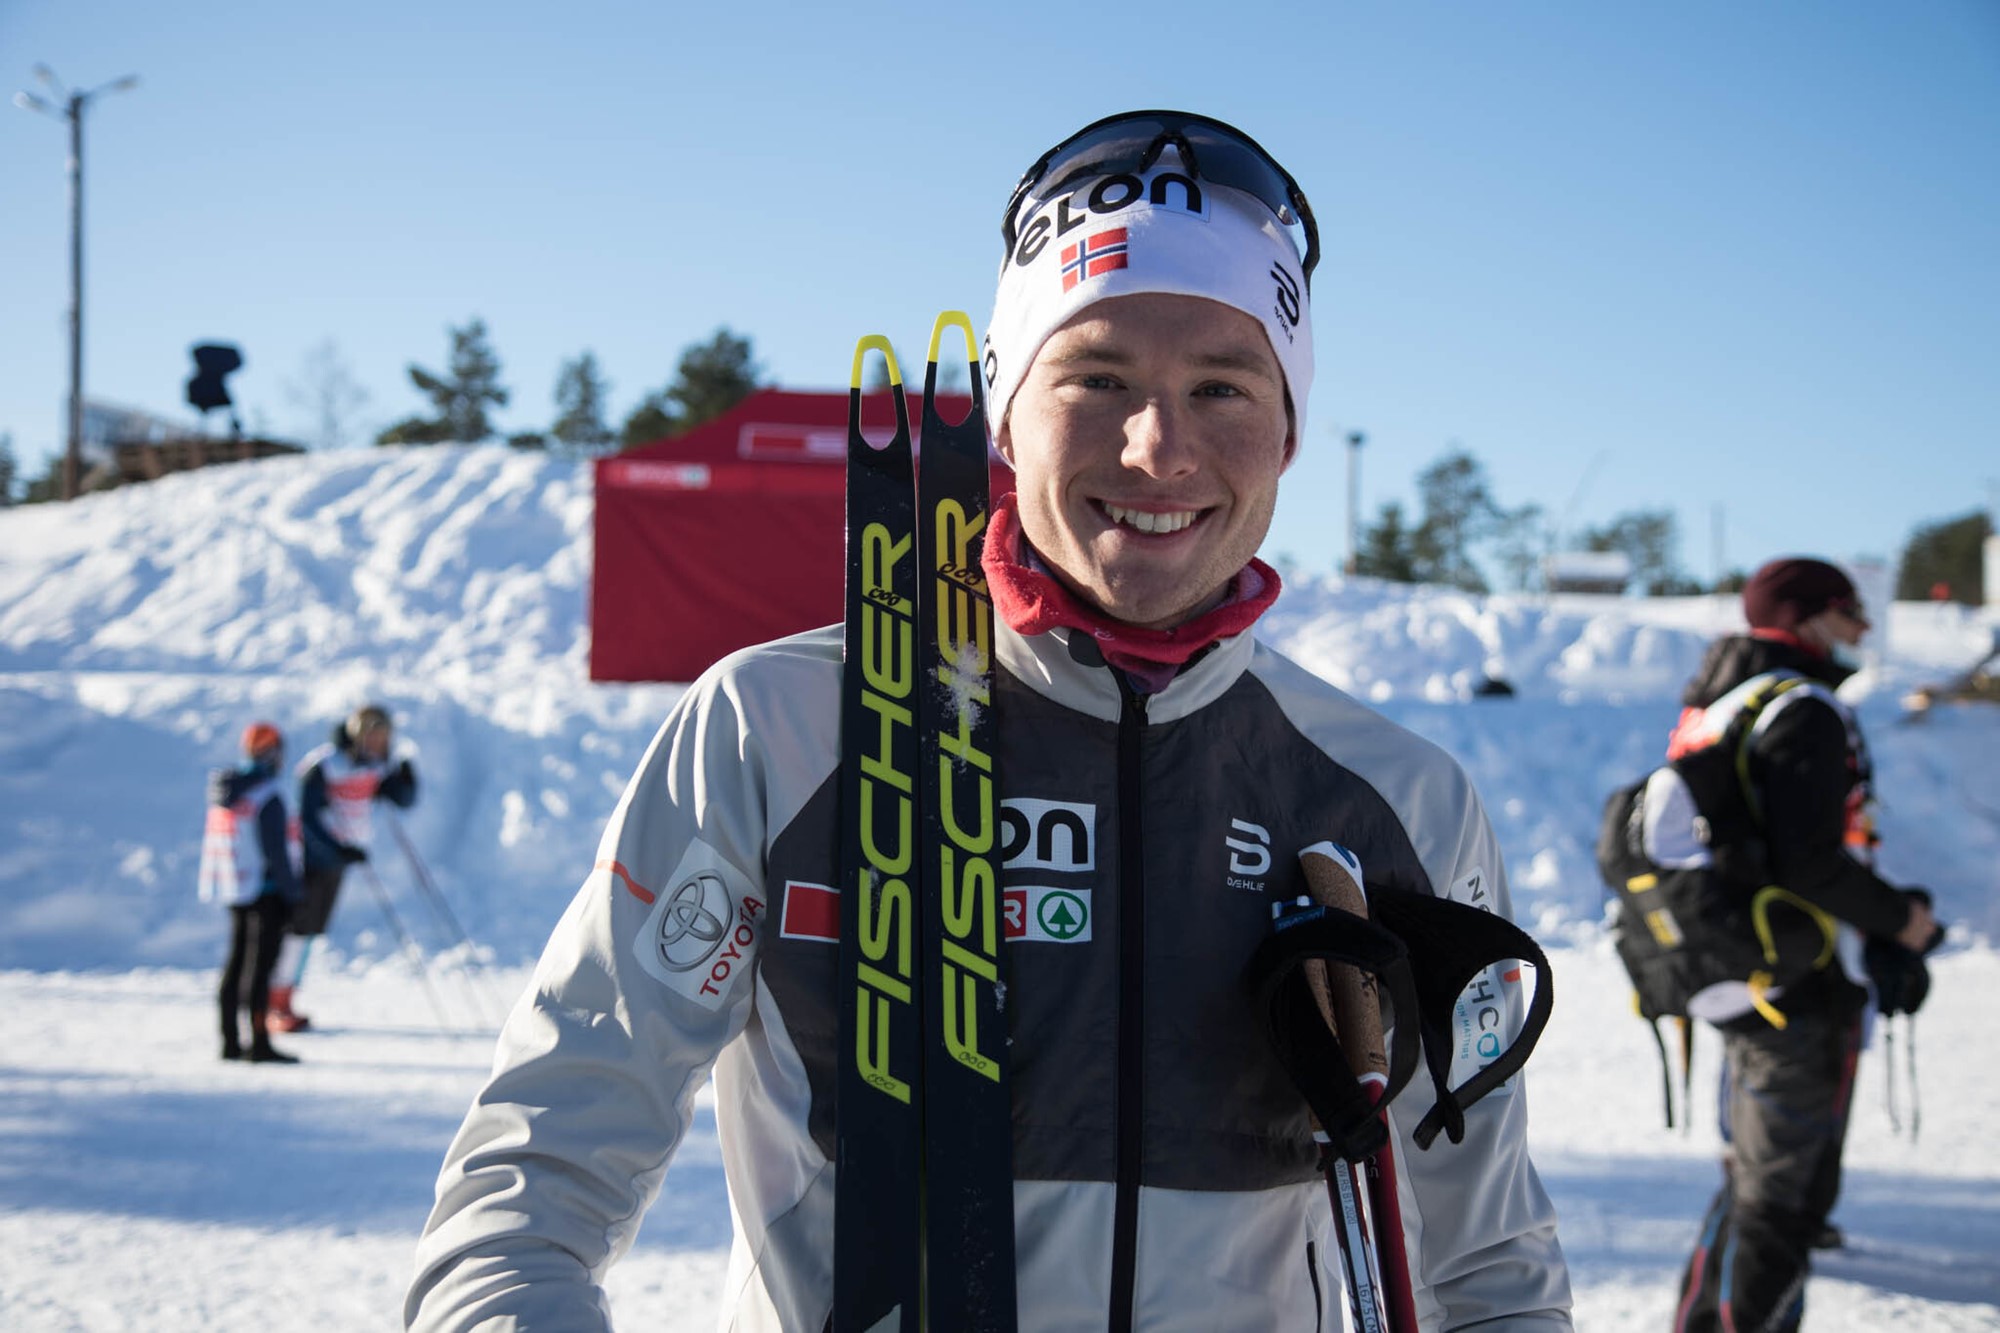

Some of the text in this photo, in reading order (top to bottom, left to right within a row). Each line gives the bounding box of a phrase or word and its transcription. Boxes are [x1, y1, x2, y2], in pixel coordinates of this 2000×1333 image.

[700, 896, 765, 996] TOYOTA
[856, 522, 912, 1104] FISCHER
[935, 498, 1000, 1083] FISCHER
